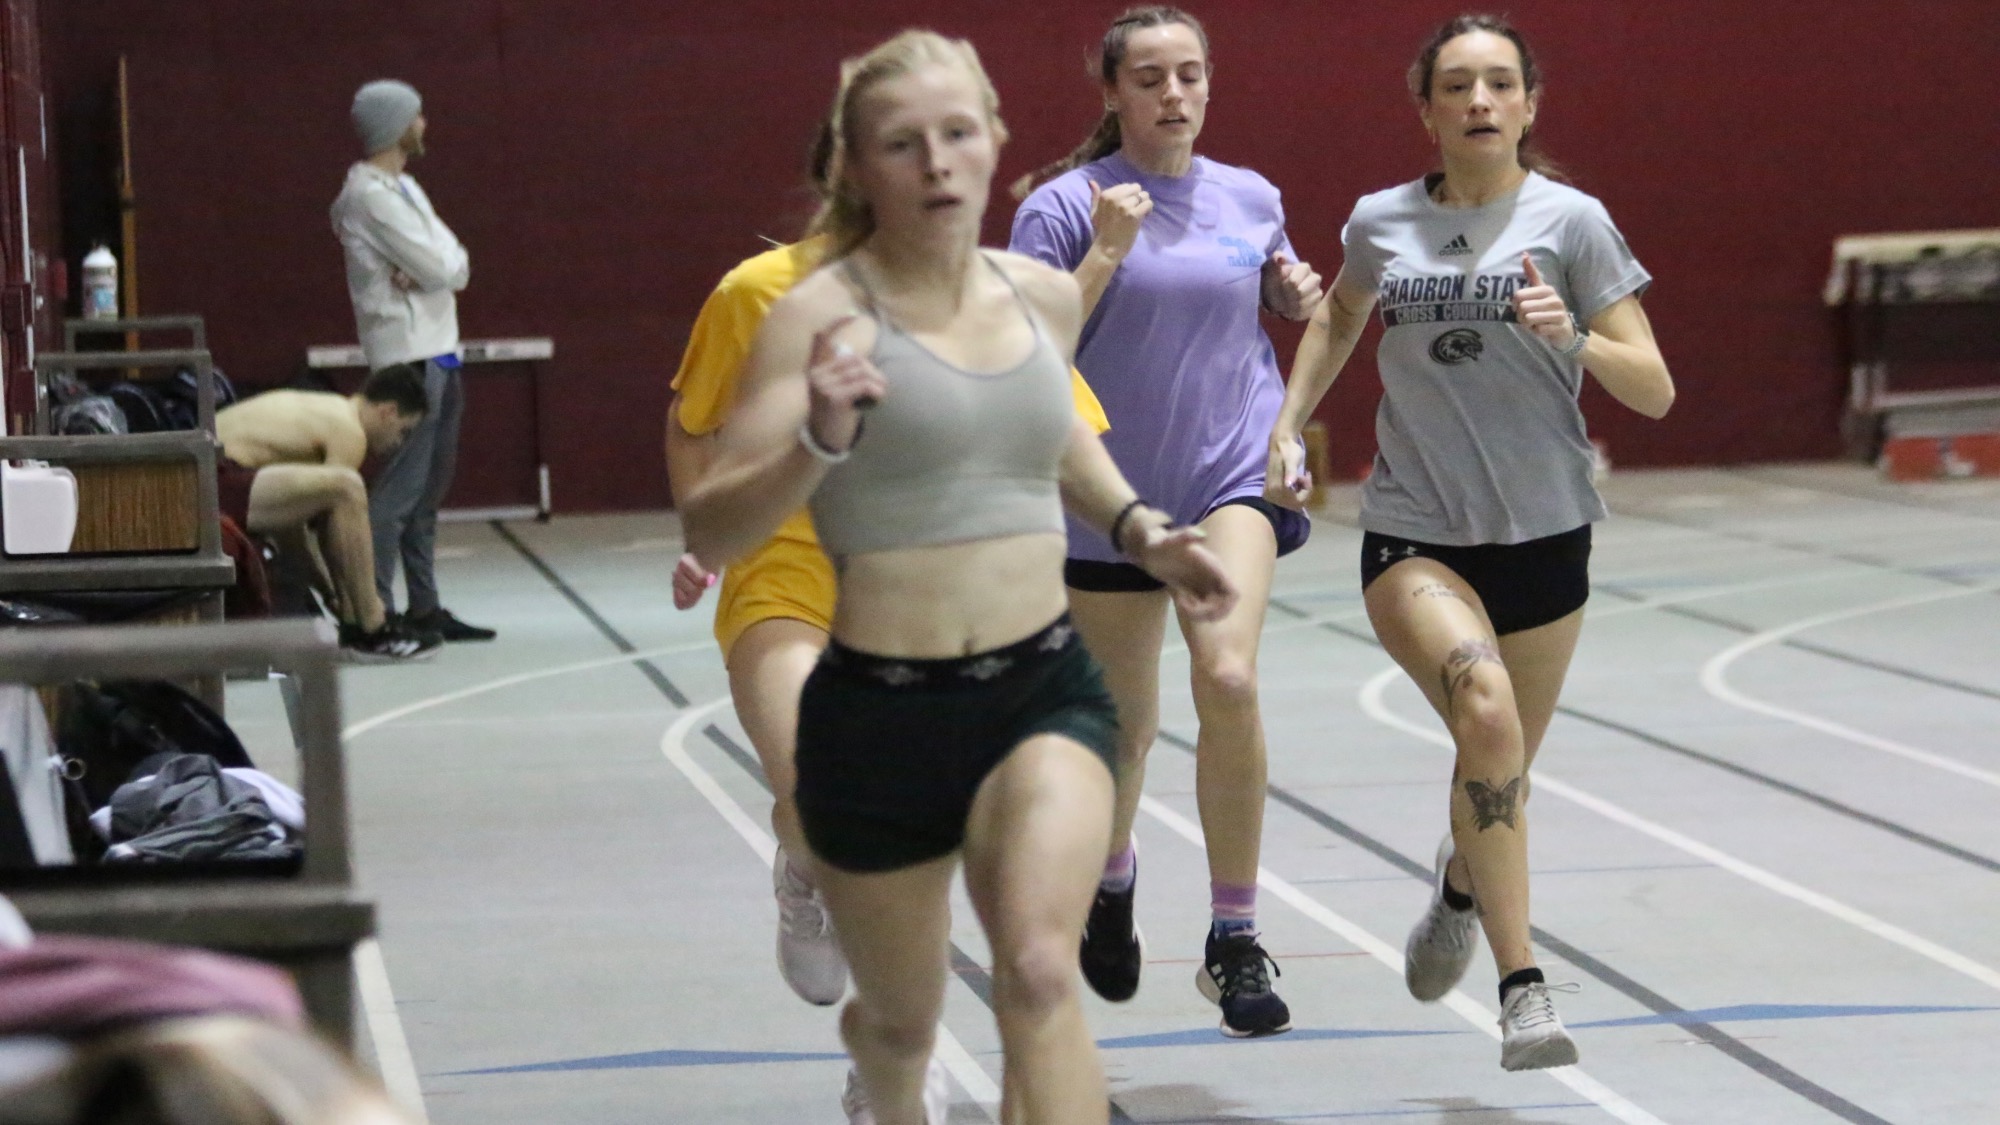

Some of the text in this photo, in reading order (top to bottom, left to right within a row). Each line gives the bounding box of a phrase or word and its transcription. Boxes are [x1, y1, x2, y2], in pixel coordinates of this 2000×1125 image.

[1381, 274, 1529, 308] CHADRON STAT
[1395, 304, 1506, 324] CROSS COUNTRY
